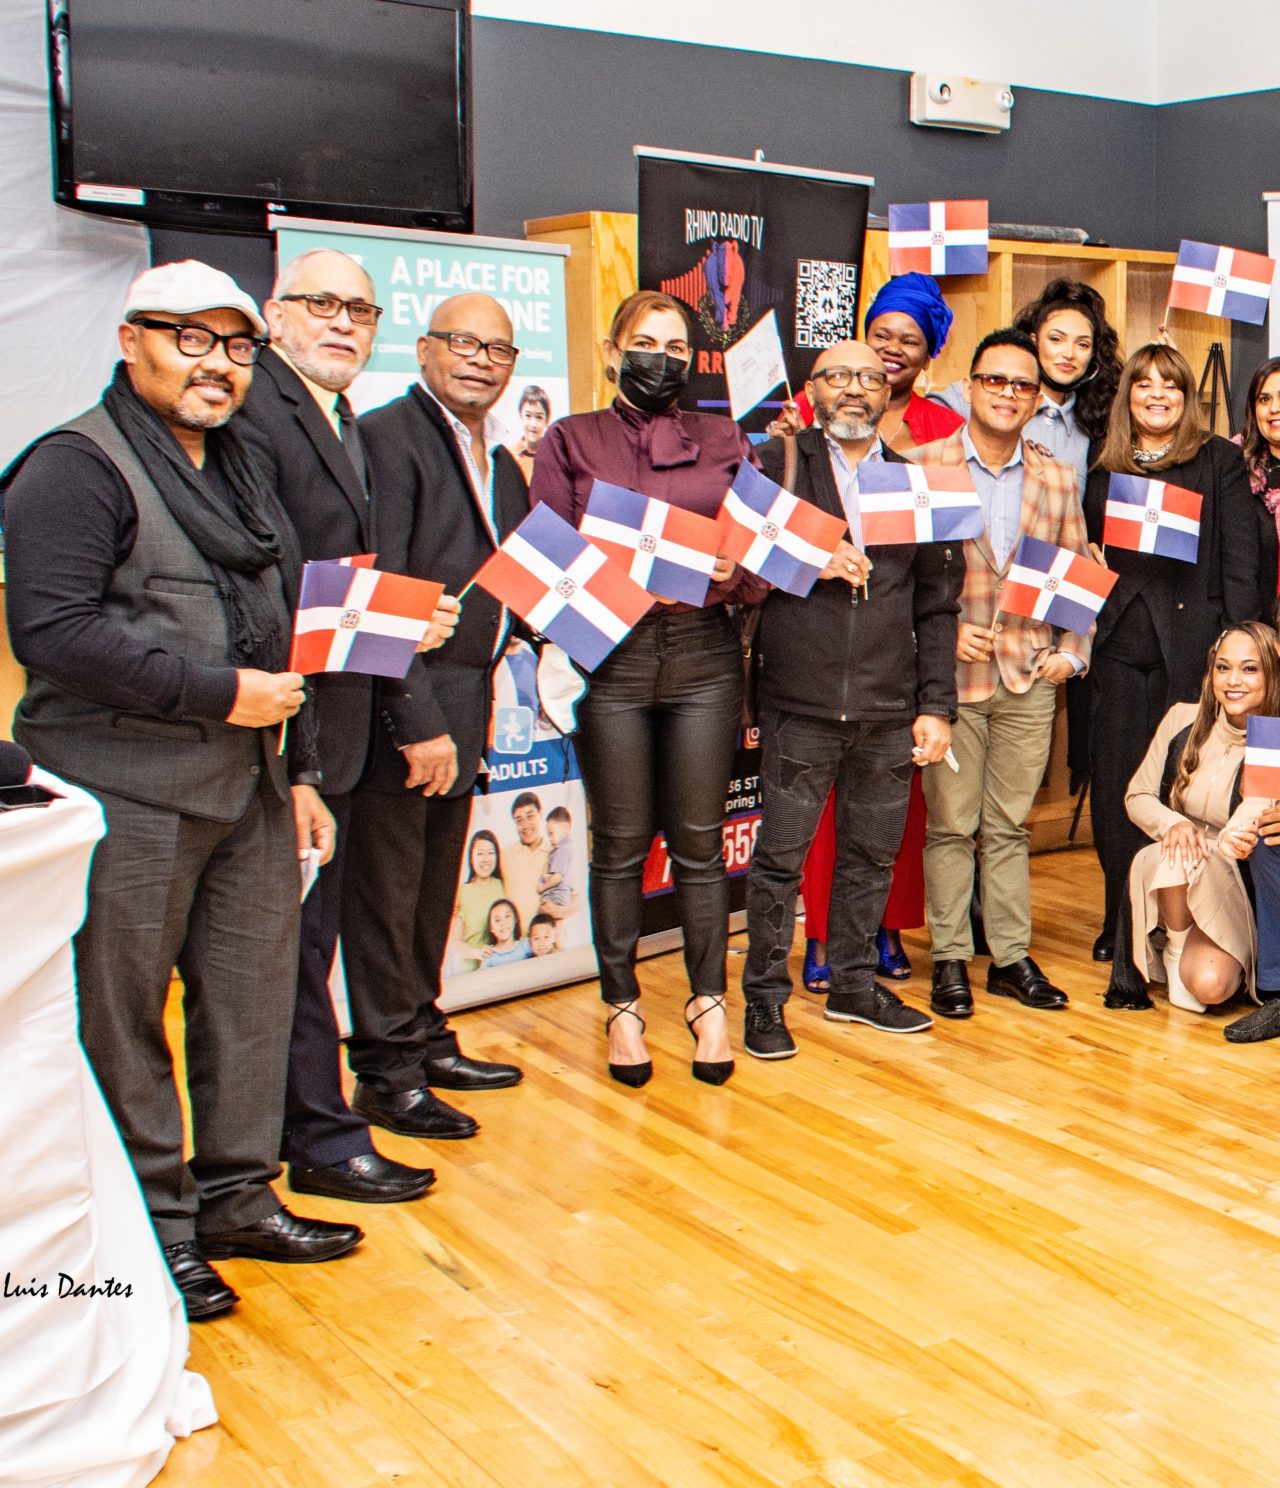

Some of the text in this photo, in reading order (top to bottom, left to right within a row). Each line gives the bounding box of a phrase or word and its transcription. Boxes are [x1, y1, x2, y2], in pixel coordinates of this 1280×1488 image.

[685, 208, 764, 250] RHINO RADIO TV
[390, 256, 551, 295] A PLACE FOR
[391, 291, 551, 332] EVNE
[488, 757, 549, 783] ADULTS
[726, 795, 755, 812] pring
